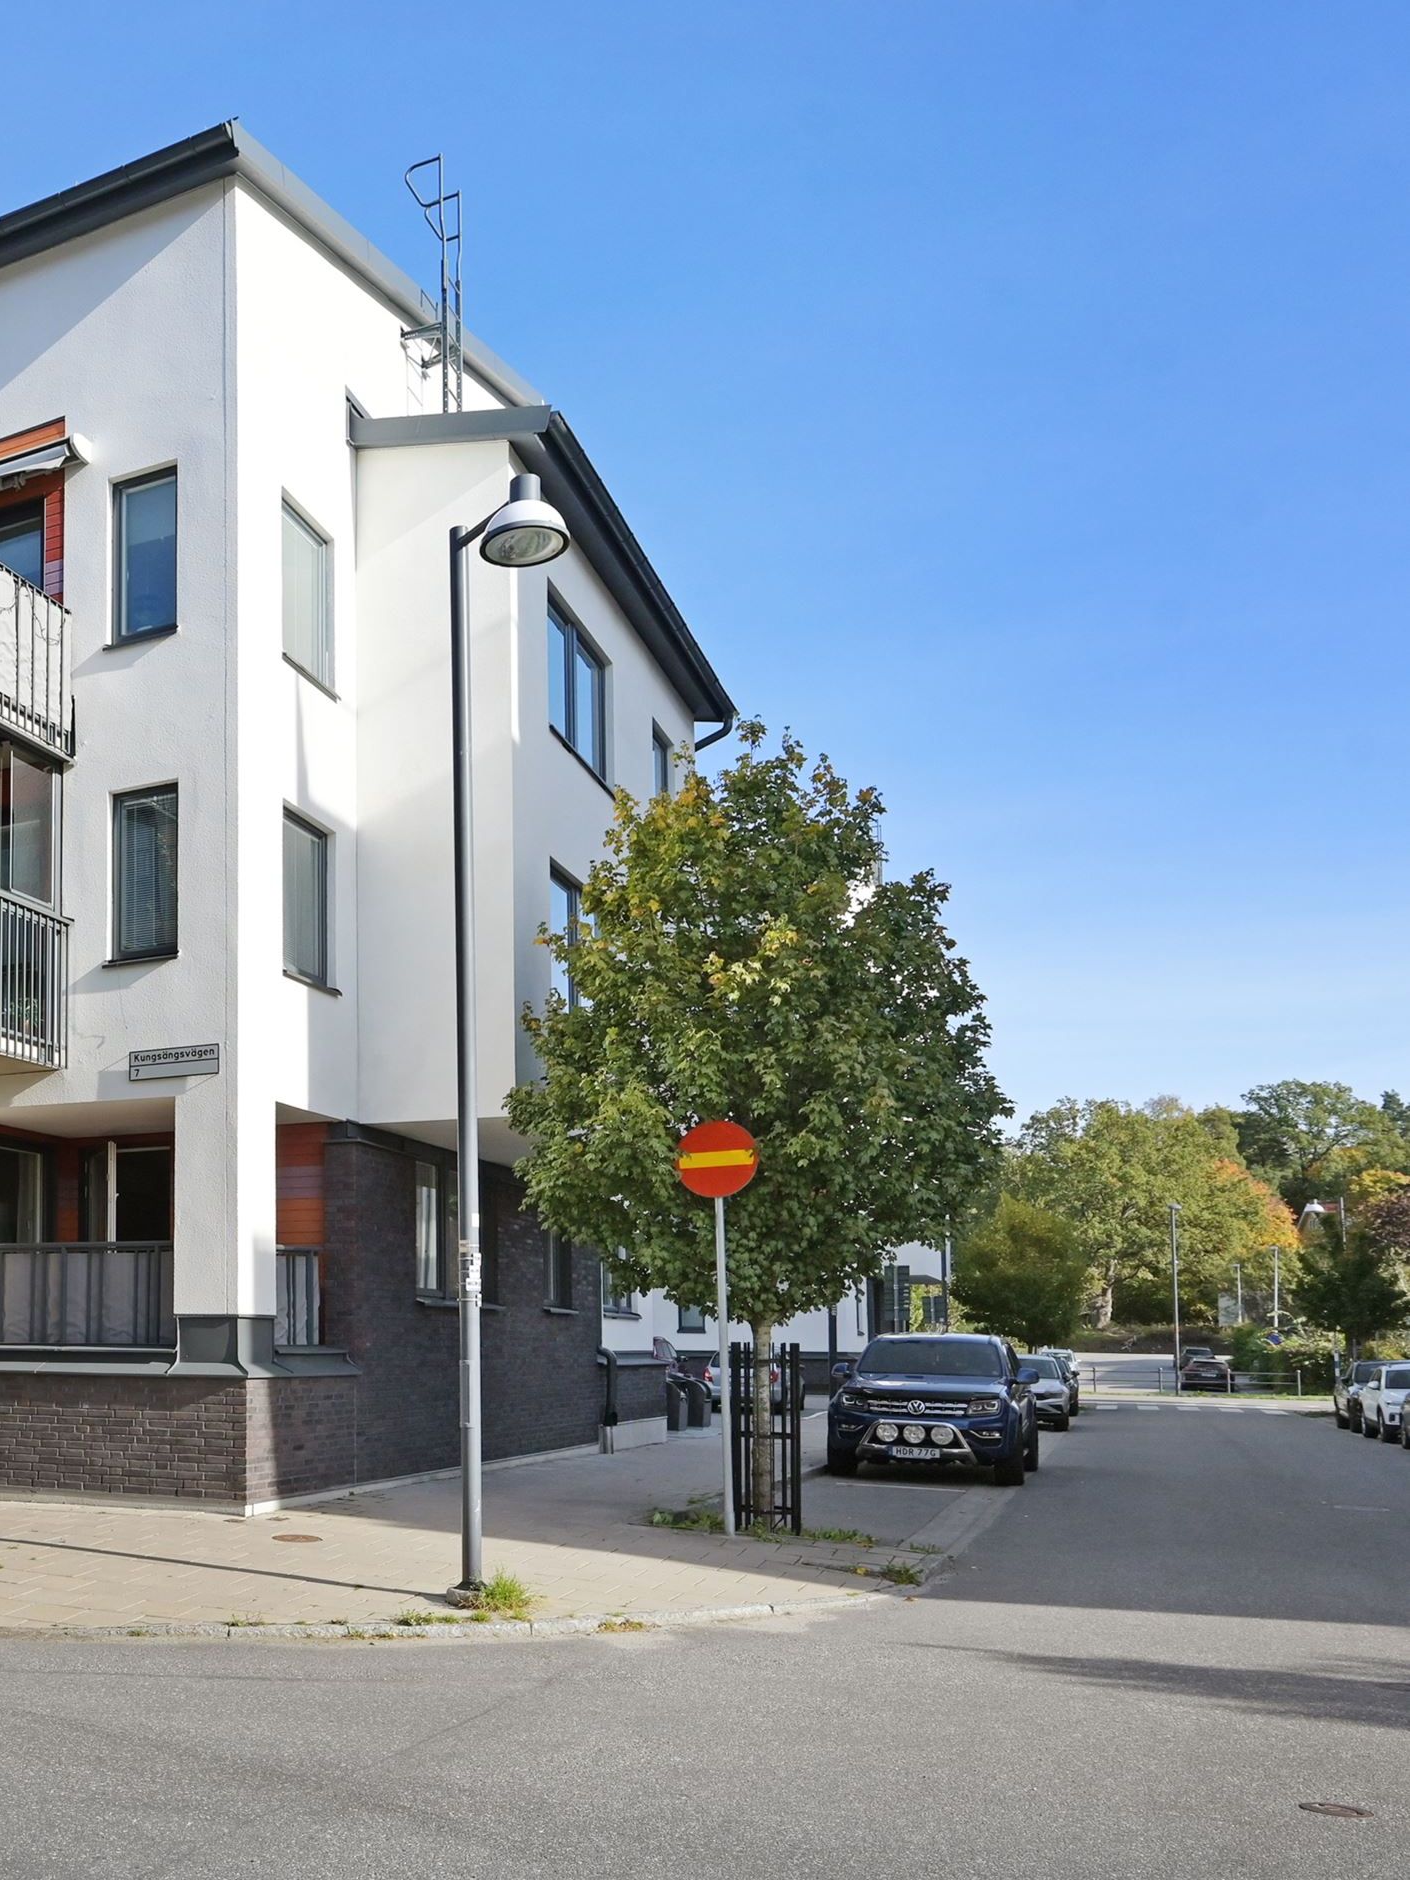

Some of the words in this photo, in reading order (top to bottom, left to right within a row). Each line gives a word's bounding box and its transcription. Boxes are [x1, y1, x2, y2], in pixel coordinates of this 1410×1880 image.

[133, 1048, 215, 1062] Kungsängsvägen
[133, 1069, 140, 1078] 7
[895, 1447, 914, 1456] HDR
[917, 1448, 936, 1457] 77G
